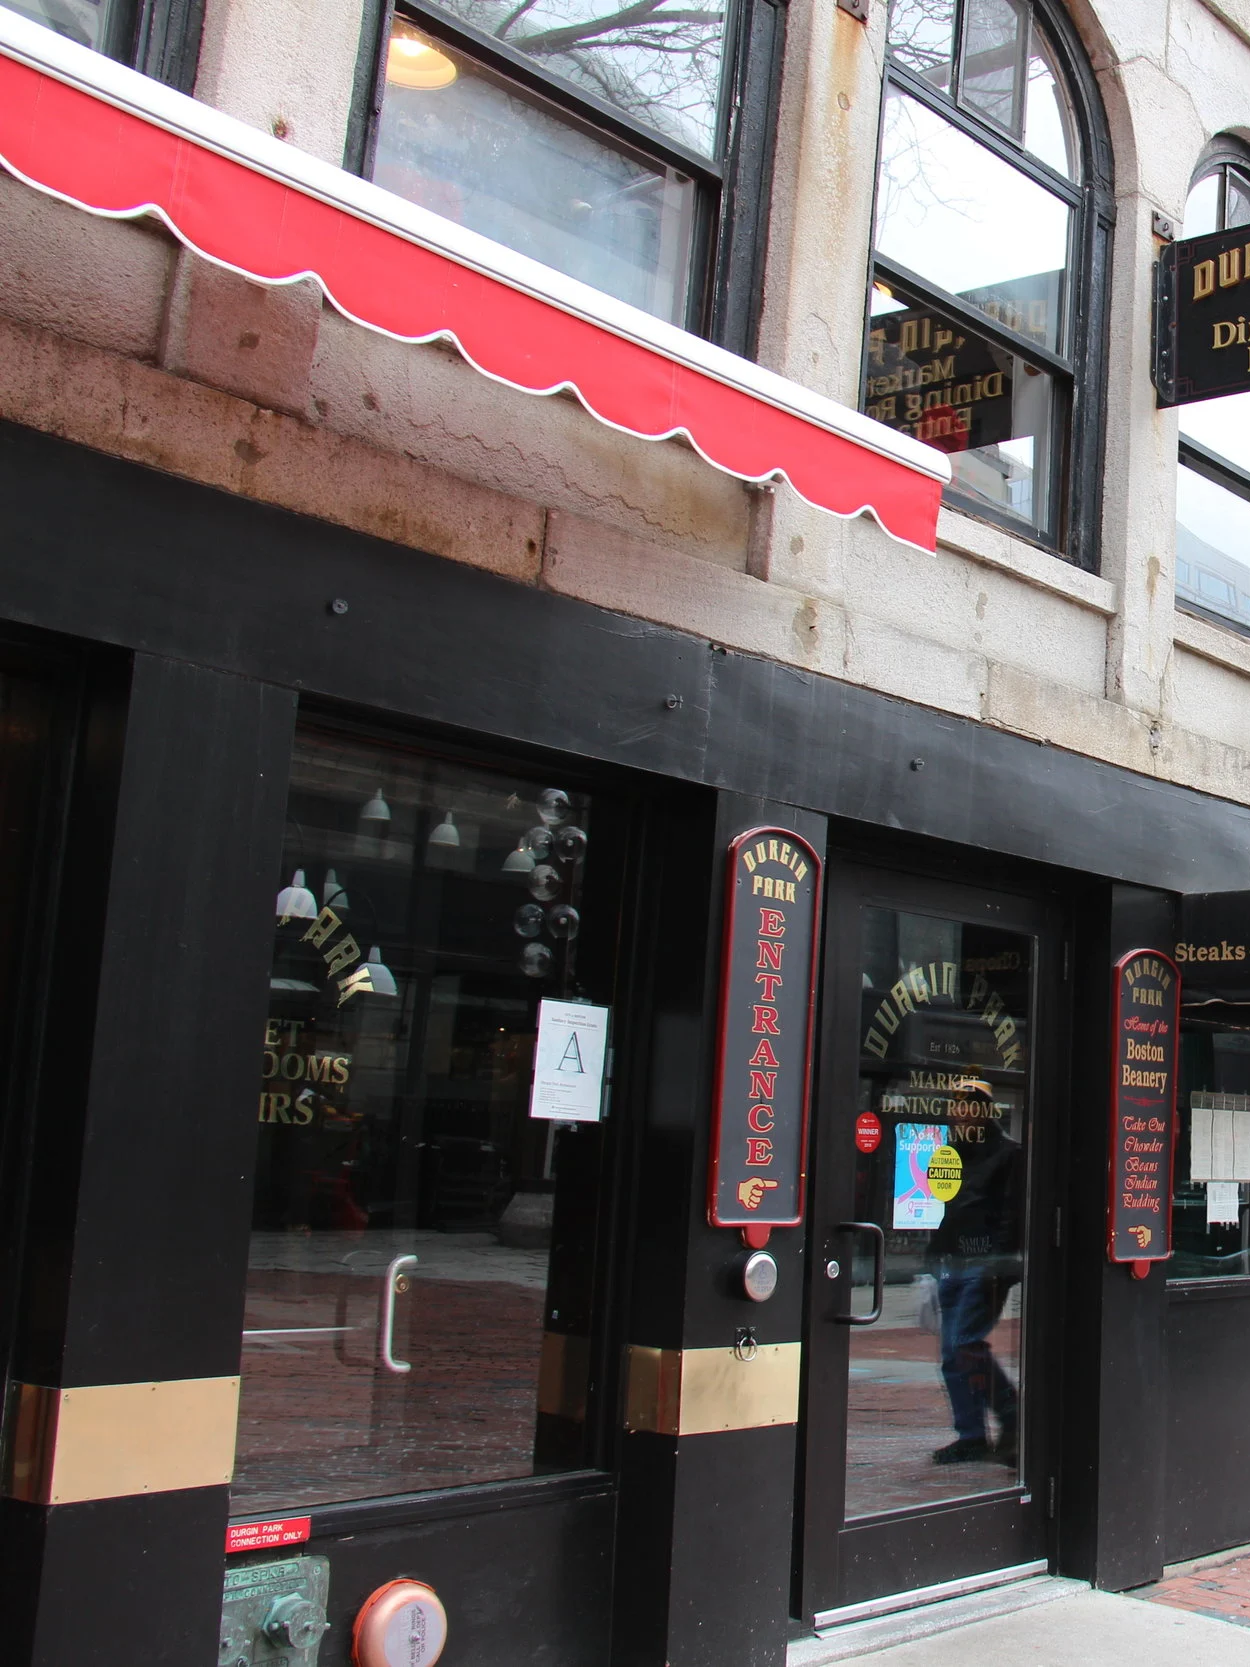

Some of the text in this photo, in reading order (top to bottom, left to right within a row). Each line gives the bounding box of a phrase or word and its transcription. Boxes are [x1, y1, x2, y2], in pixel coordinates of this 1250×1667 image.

[743, 839, 808, 882] DURGIN
[752, 875, 796, 904] PARK
[1174, 940, 1246, 962] Steaks
[1125, 958, 1171, 991] DURGIN
[1132, 987, 1162, 1007] PARK
[863, 961, 1023, 1072] DURGIN PARK
[1123, 1015, 1169, 1037] Home of the
[745, 906, 786, 1166] ENTRANCE
[553, 1031, 586, 1074] A
[1126, 1038, 1164, 1062] Boston
[909, 1070, 980, 1093] MARKET
[1122, 1064, 1168, 1094] Beanery
[881, 1095, 1003, 1120] DINING ROOMS
[858, 1128, 879, 1136] WINNER
[1122, 1115, 1166, 1132] Take Out
[1124, 1136, 1164, 1153] Chowder
[931, 1157, 960, 1165] AUTOMATIC
[1125, 1156, 1159, 1172] Beans
[929, 1168, 961, 1180] CAUTION
[1124, 1174, 1158, 1190] Indian
[937, 1182, 952, 1190] DOOR
[1122, 1193, 1161, 1213] Pudding
[231, 1524, 283, 1538] DURGIN PARK
[231, 1531, 302, 1548] CONNECTION ONLY
